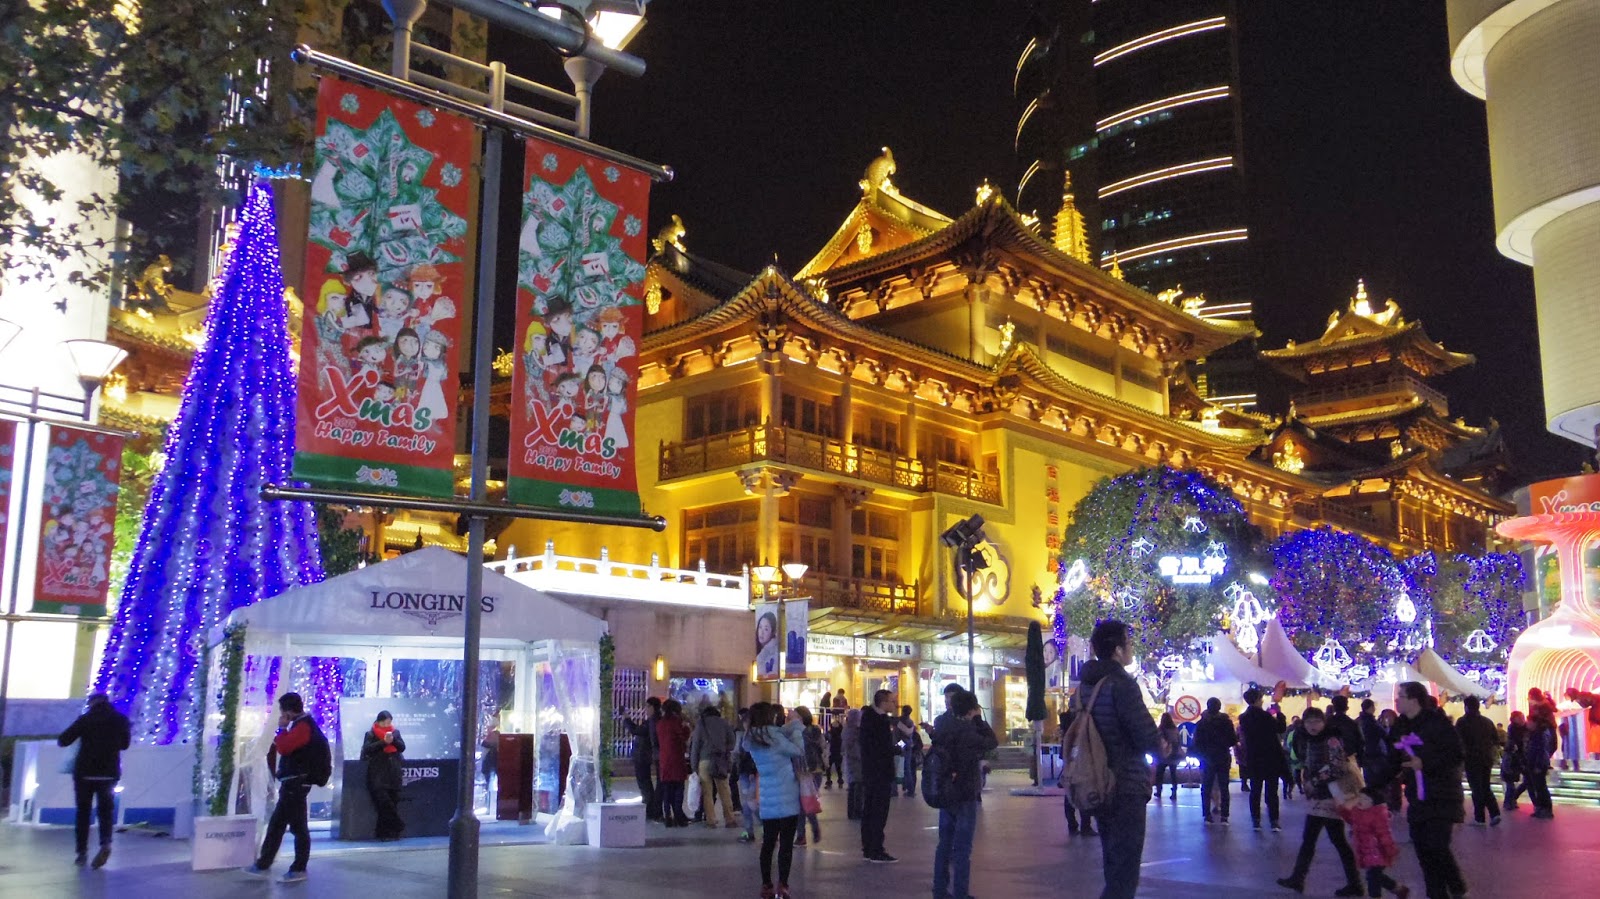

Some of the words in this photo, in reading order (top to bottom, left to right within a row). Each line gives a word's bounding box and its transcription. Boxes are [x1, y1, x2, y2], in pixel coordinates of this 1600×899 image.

[315, 365, 432, 432] X'mas
[315, 421, 374, 446] Happy
[377, 430, 436, 455] Family
[524, 399, 616, 460] X'mas
[524, 449, 572, 472] Happy
[574, 456, 621, 478] Family
[42, 558, 99, 588] X'mas
[370, 592, 494, 613] LONGINS
